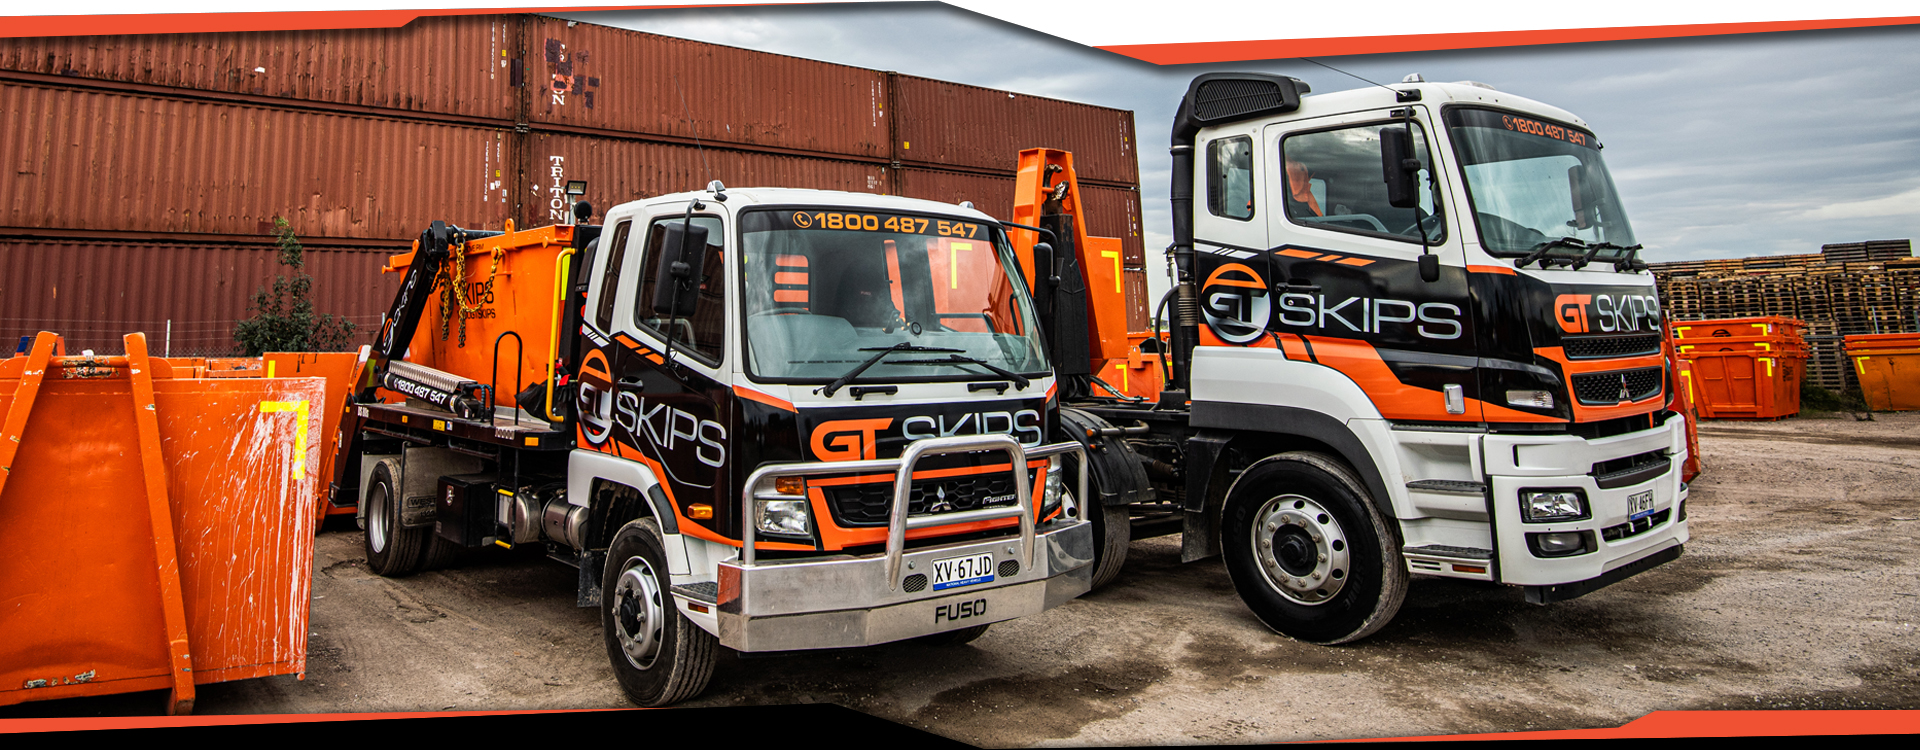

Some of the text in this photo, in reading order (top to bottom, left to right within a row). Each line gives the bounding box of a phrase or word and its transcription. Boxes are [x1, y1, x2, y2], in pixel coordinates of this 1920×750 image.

[1513, 117, 1586, 146] 1800 487 547
[549, 156, 564, 220] TRITON
[814, 212, 978, 239] 1800 487 547
[456, 281, 494, 305] KIPS
[1279, 292, 1462, 340] SKIPS
[1554, 294, 1659, 333] GT SKIPS
[398, 379, 447, 405] 1800 487 547
[615, 391, 727, 468] SKIPS
[810, 409, 1043, 462] GT SKIPS
[935, 598, 987, 624] FUSO
